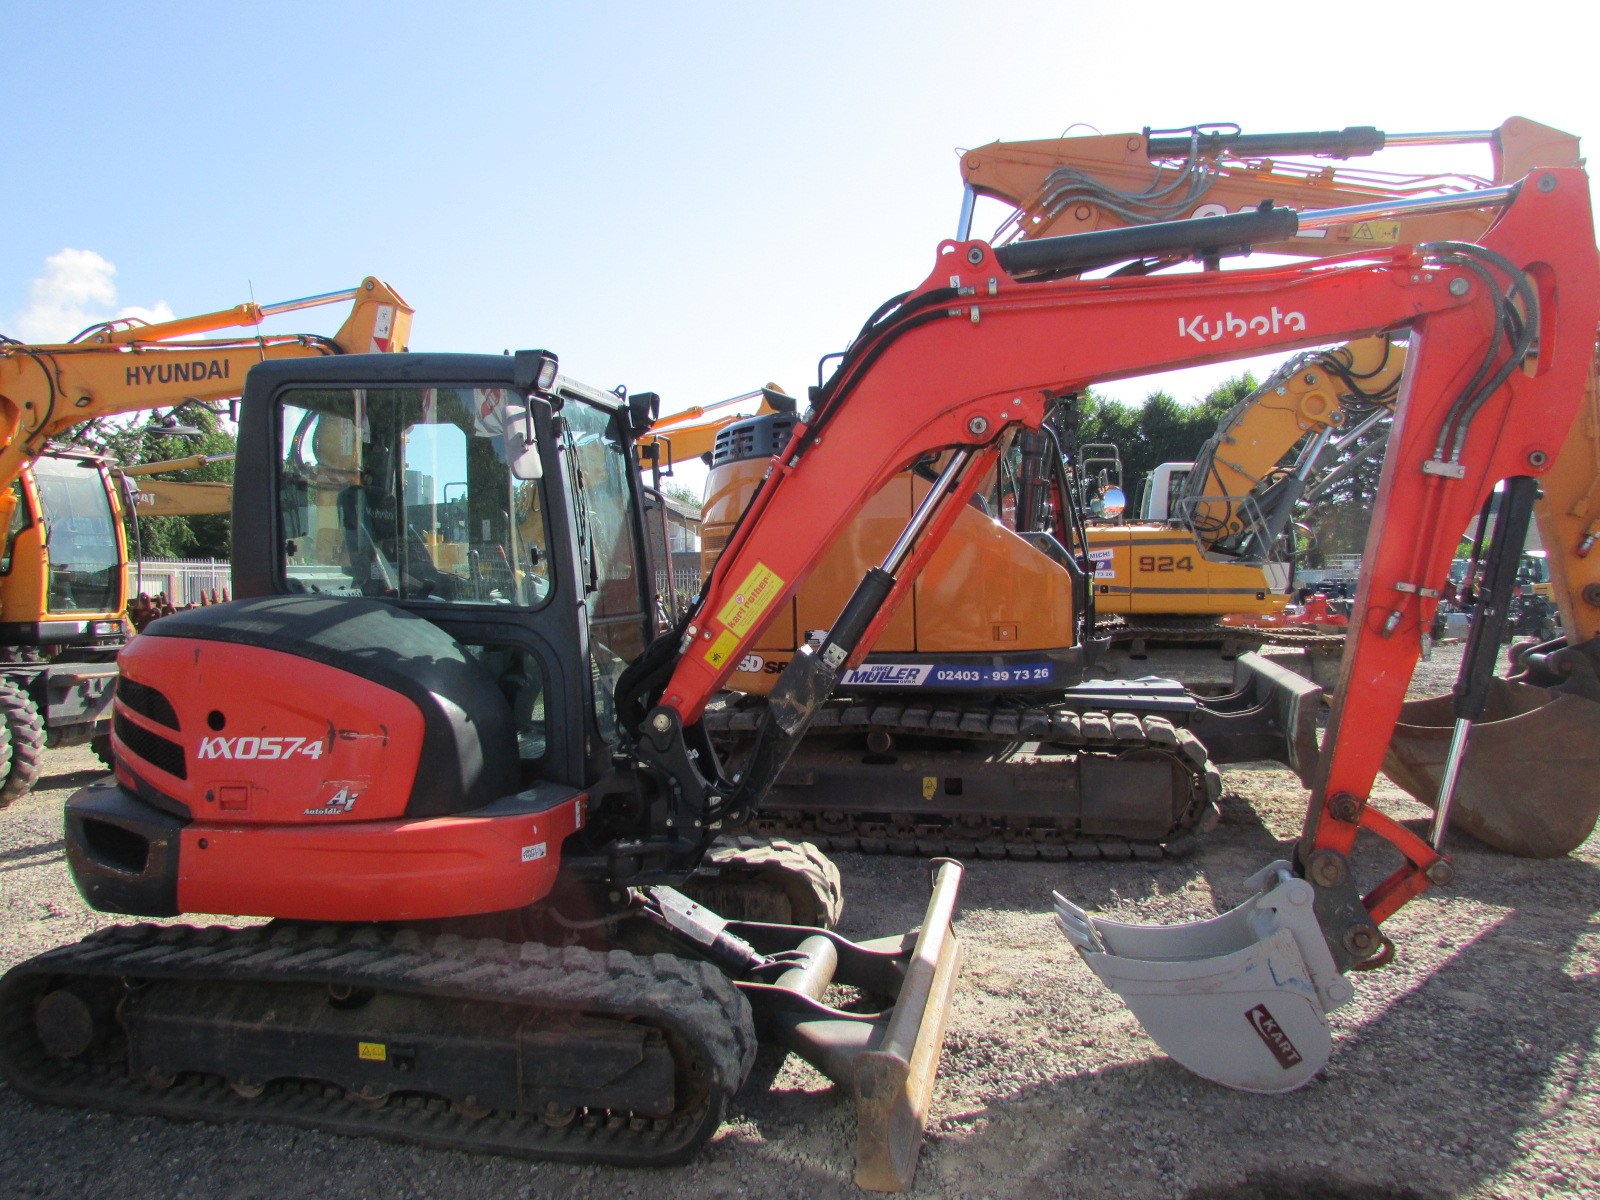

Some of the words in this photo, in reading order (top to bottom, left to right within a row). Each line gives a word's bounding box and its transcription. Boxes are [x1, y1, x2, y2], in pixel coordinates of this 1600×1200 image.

[1178, 306, 1306, 342] Kubota
[126, 358, 230, 386] HYUNDAI
[1089, 551, 1110, 559] MICH!
[1139, 556, 1194, 572] 924
[736, 654, 764, 672] 5D
[937, 670, 979, 681] 02403
[992, 671, 1009, 680] 99
[1013, 670, 1029, 679] 73
[1033, 668, 1049, 678] 26
[197, 736, 323, 760] KX057-4
[326, 785, 359, 812] Ai
[1263, 1018, 1299, 1060] KART
